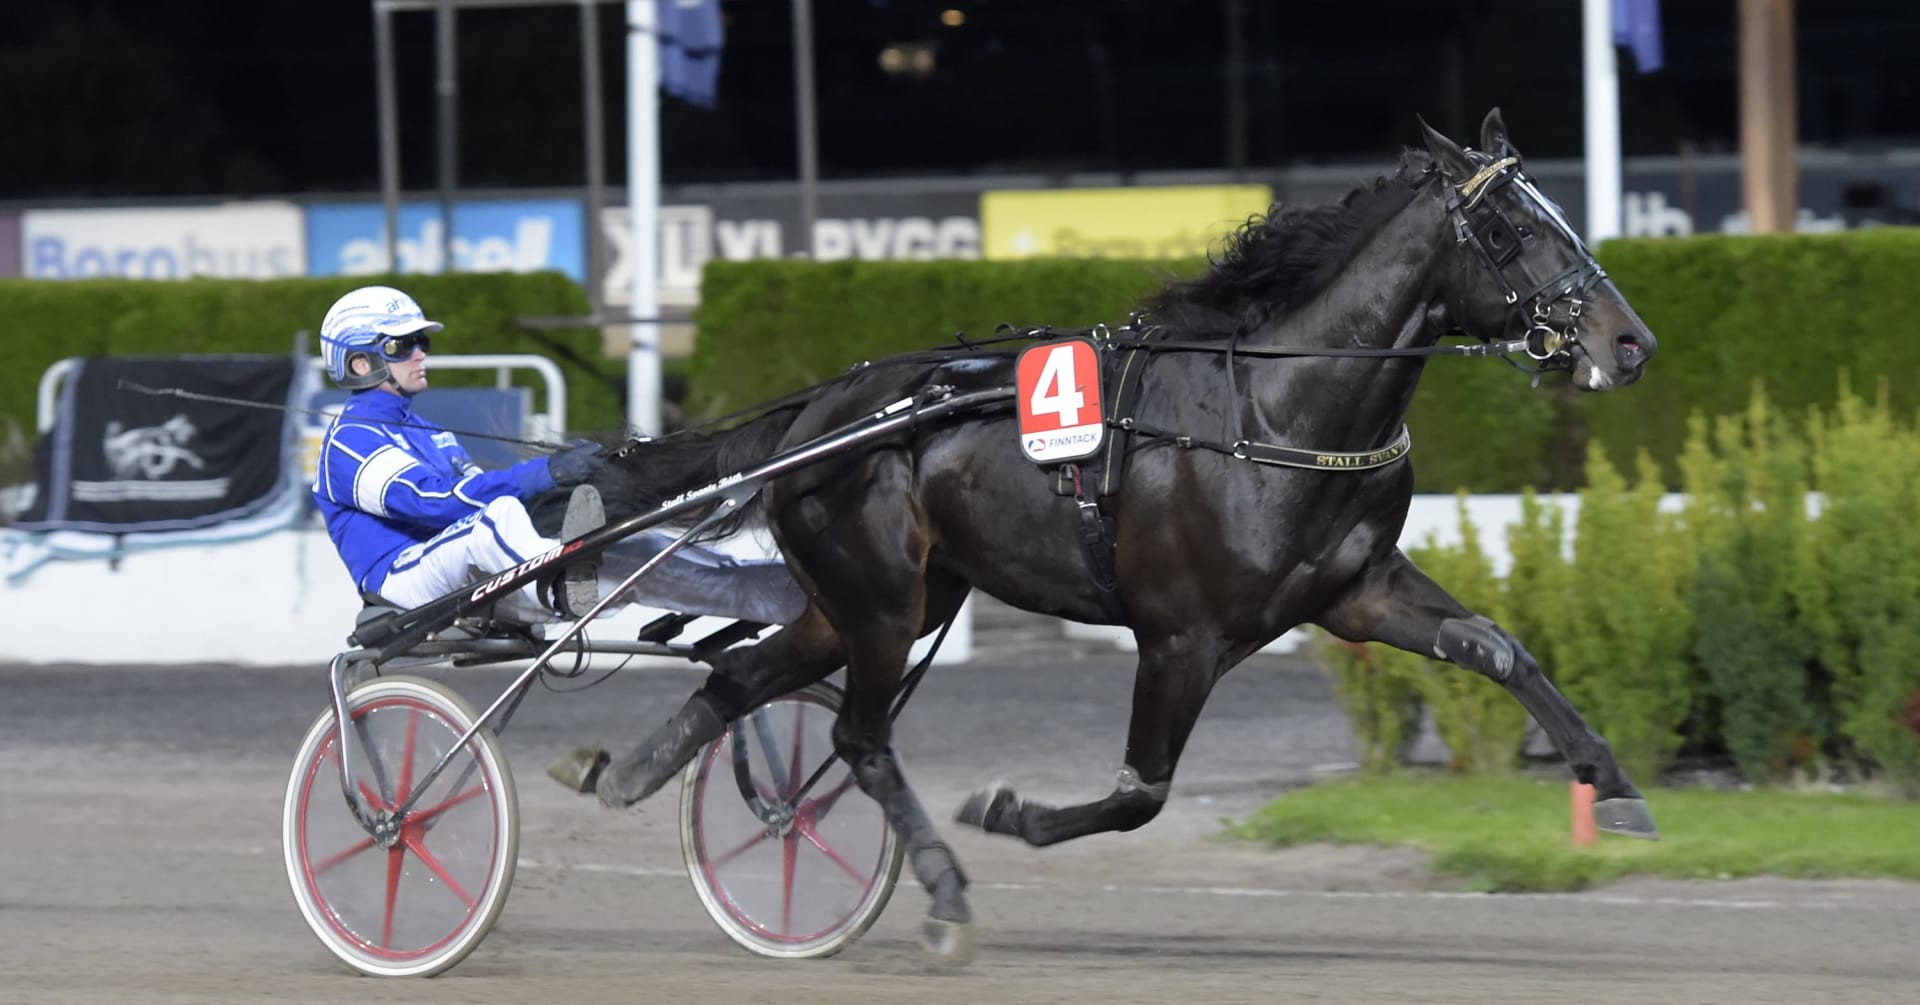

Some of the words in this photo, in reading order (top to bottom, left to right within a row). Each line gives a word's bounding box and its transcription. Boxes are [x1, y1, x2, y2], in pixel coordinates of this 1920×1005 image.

[1031, 345, 1084, 427] 4
[1049, 433, 1097, 447] FINNTACK
[1316, 455, 1364, 467] STALL
[471, 545, 564, 602] CUSTOM
